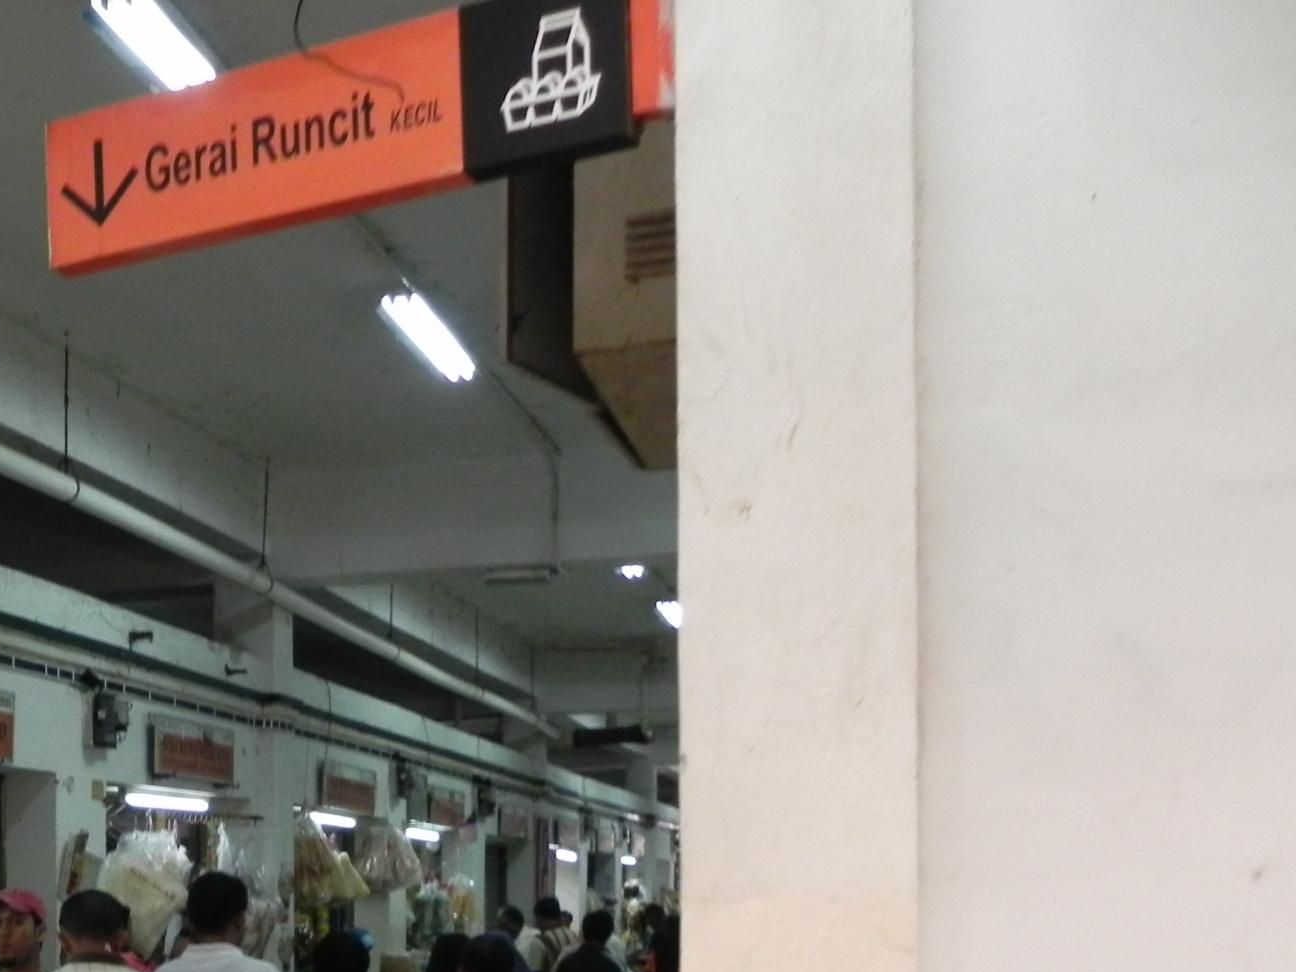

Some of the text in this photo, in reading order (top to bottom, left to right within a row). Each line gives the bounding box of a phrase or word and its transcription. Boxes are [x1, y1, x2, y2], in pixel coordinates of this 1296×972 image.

[145, 92, 442, 192] Gerai Runcit KECIL
